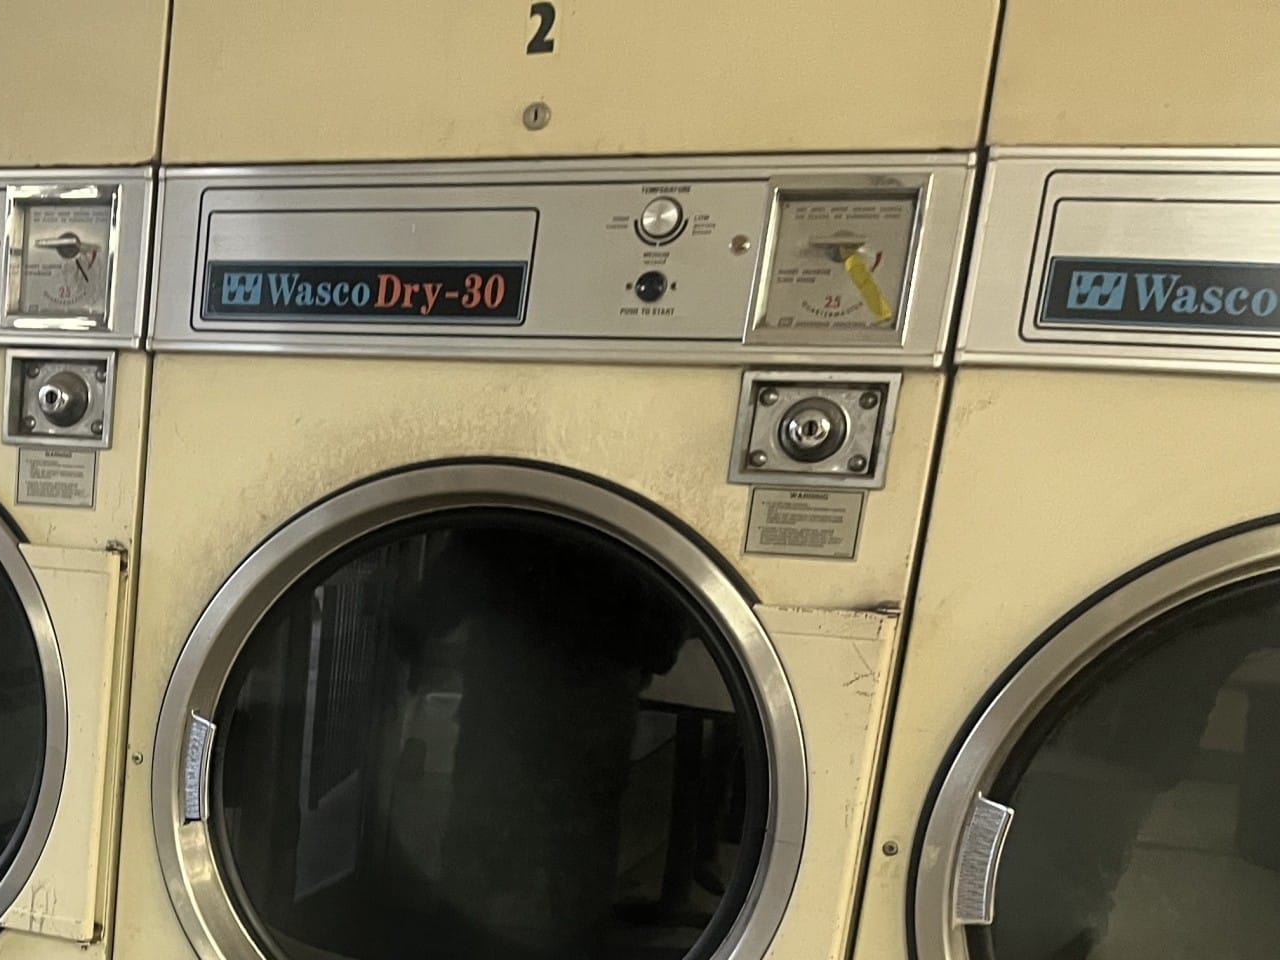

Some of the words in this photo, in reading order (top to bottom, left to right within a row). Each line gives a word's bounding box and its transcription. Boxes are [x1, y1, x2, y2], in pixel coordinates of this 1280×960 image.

[526, 2, 556, 56] 2
[268, 273, 371, 307] Wasco
[373, 273, 506, 316] Dry-30
[1134, 273, 1277, 317] Wasco
